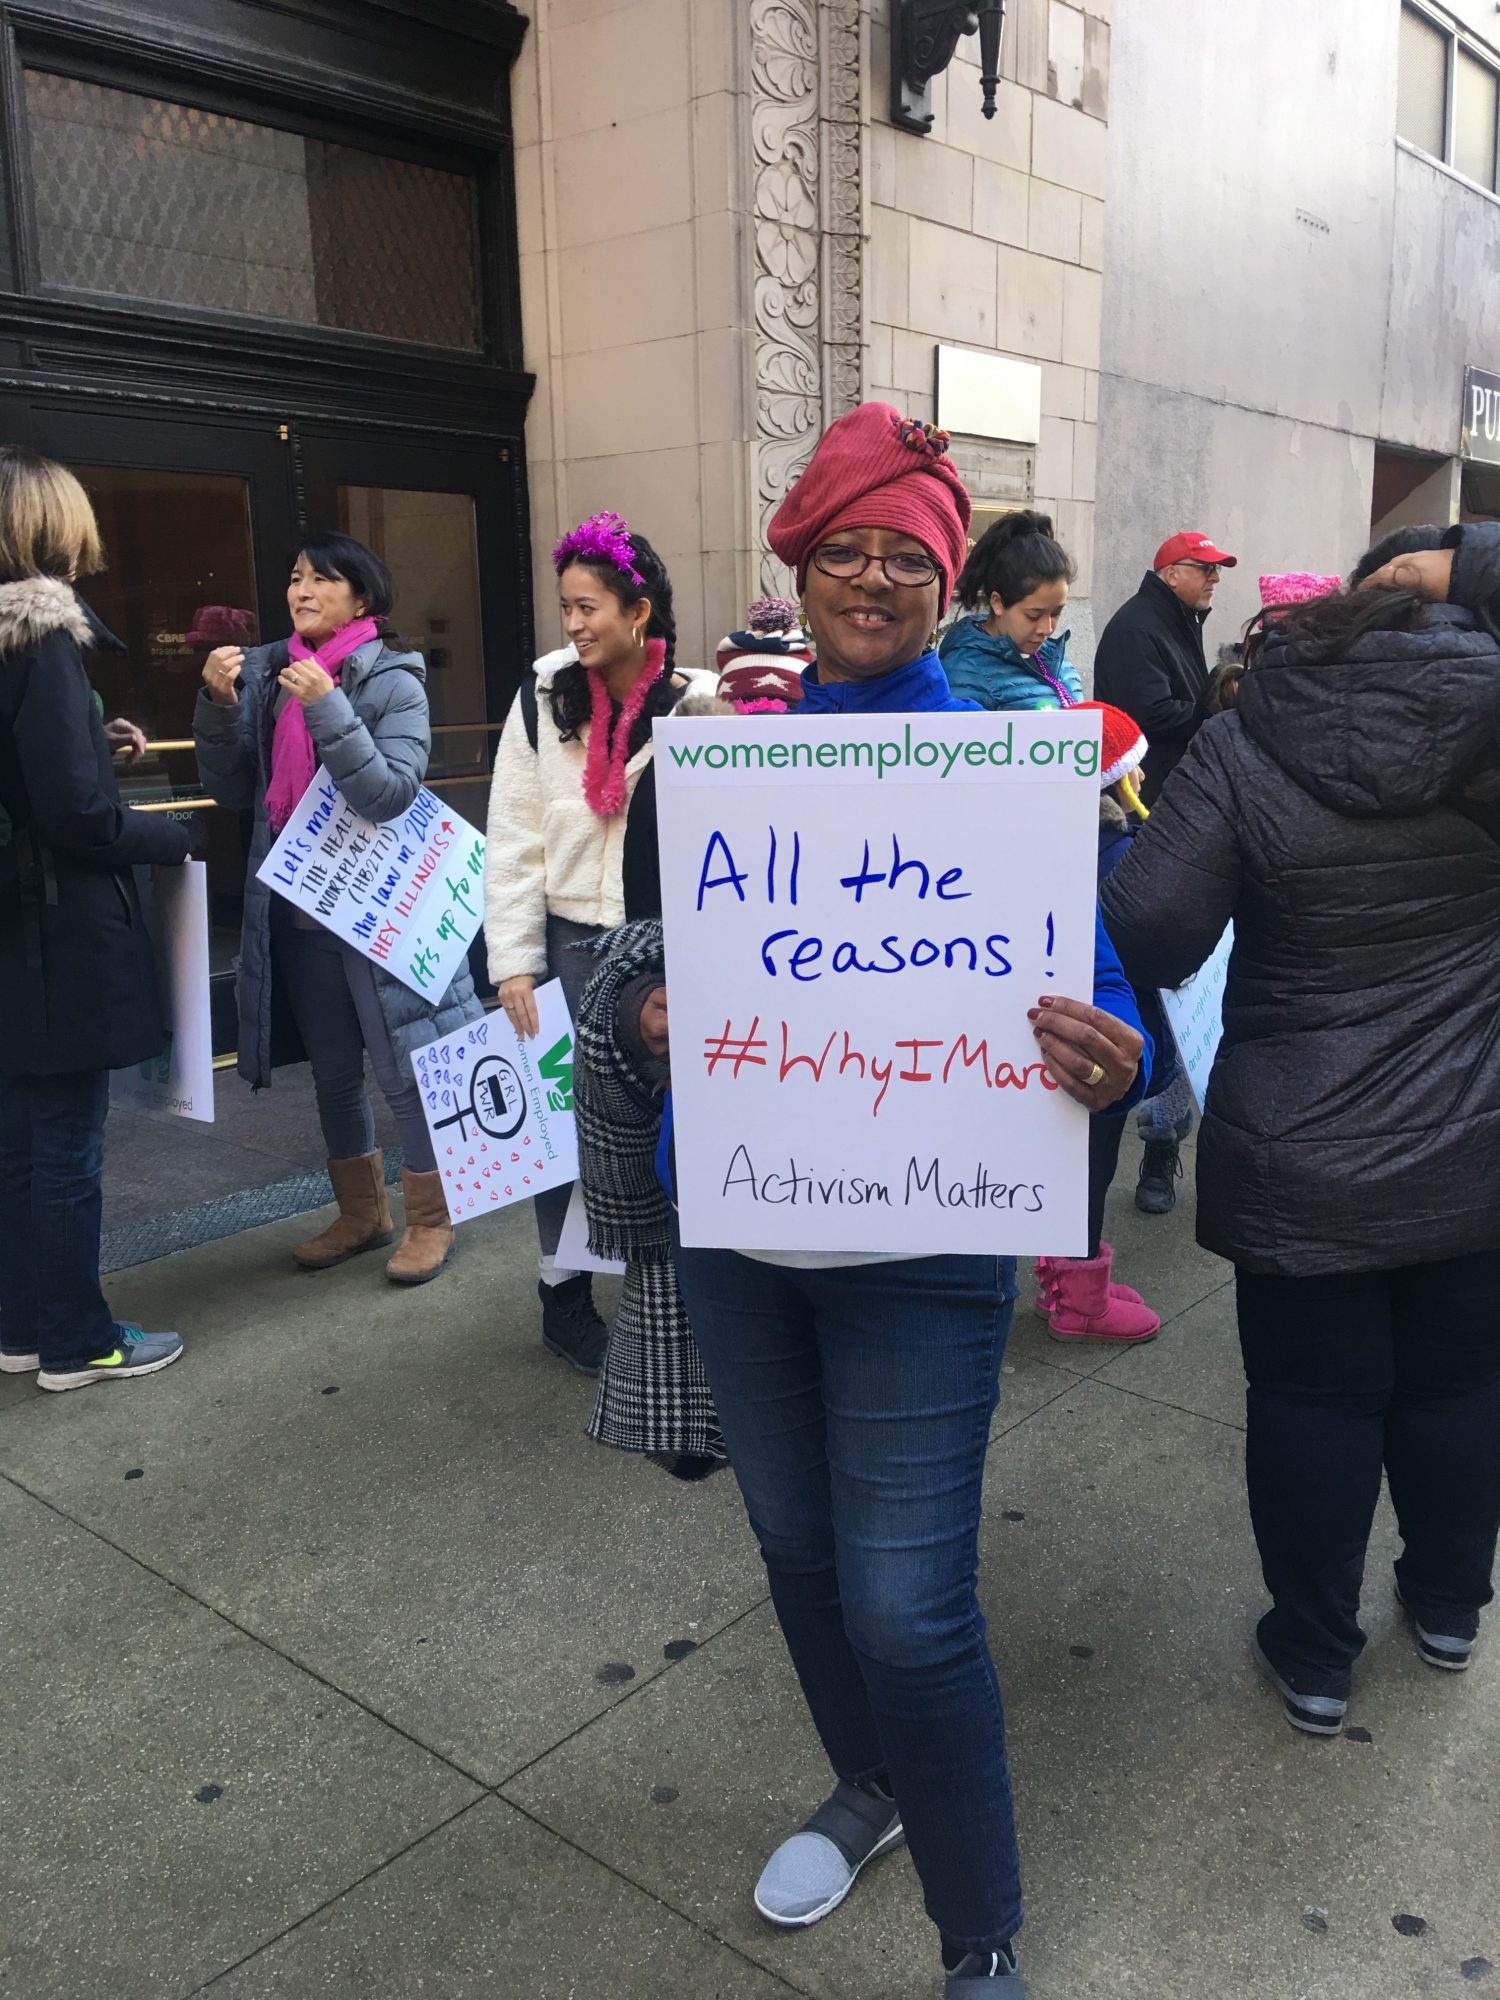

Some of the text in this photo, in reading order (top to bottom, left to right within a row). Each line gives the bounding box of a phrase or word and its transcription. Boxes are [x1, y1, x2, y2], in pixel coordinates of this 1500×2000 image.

[156, 633, 186, 643] CBRE
[670, 722, 1098, 778] womenemployed.org
[166, 810, 193, 821] Door
[273, 838, 312, 886] Let's
[299, 803, 358, 894] THE HEALT
[315, 830, 370, 916] WORKPLACE
[696, 825, 972, 911] All the
[352, 911, 377, 939] the
[371, 866, 401, 907] law
[397, 845, 415, 864] in
[368, 833, 449, 960] HEY ILLINOIS
[409, 839, 486, 988] It's up to us
[1179, 1026, 1192, 1047] the
[1191, 984, 1213, 1021] rights
[1188, 1016, 1218, 1072] and girls
[476, 1079, 496, 1122] PWR
[498, 1069, 518, 1112] GRL
[530, 1086, 559, 1161] Employed
[722, 1144, 1045, 1212] Activism Matters
